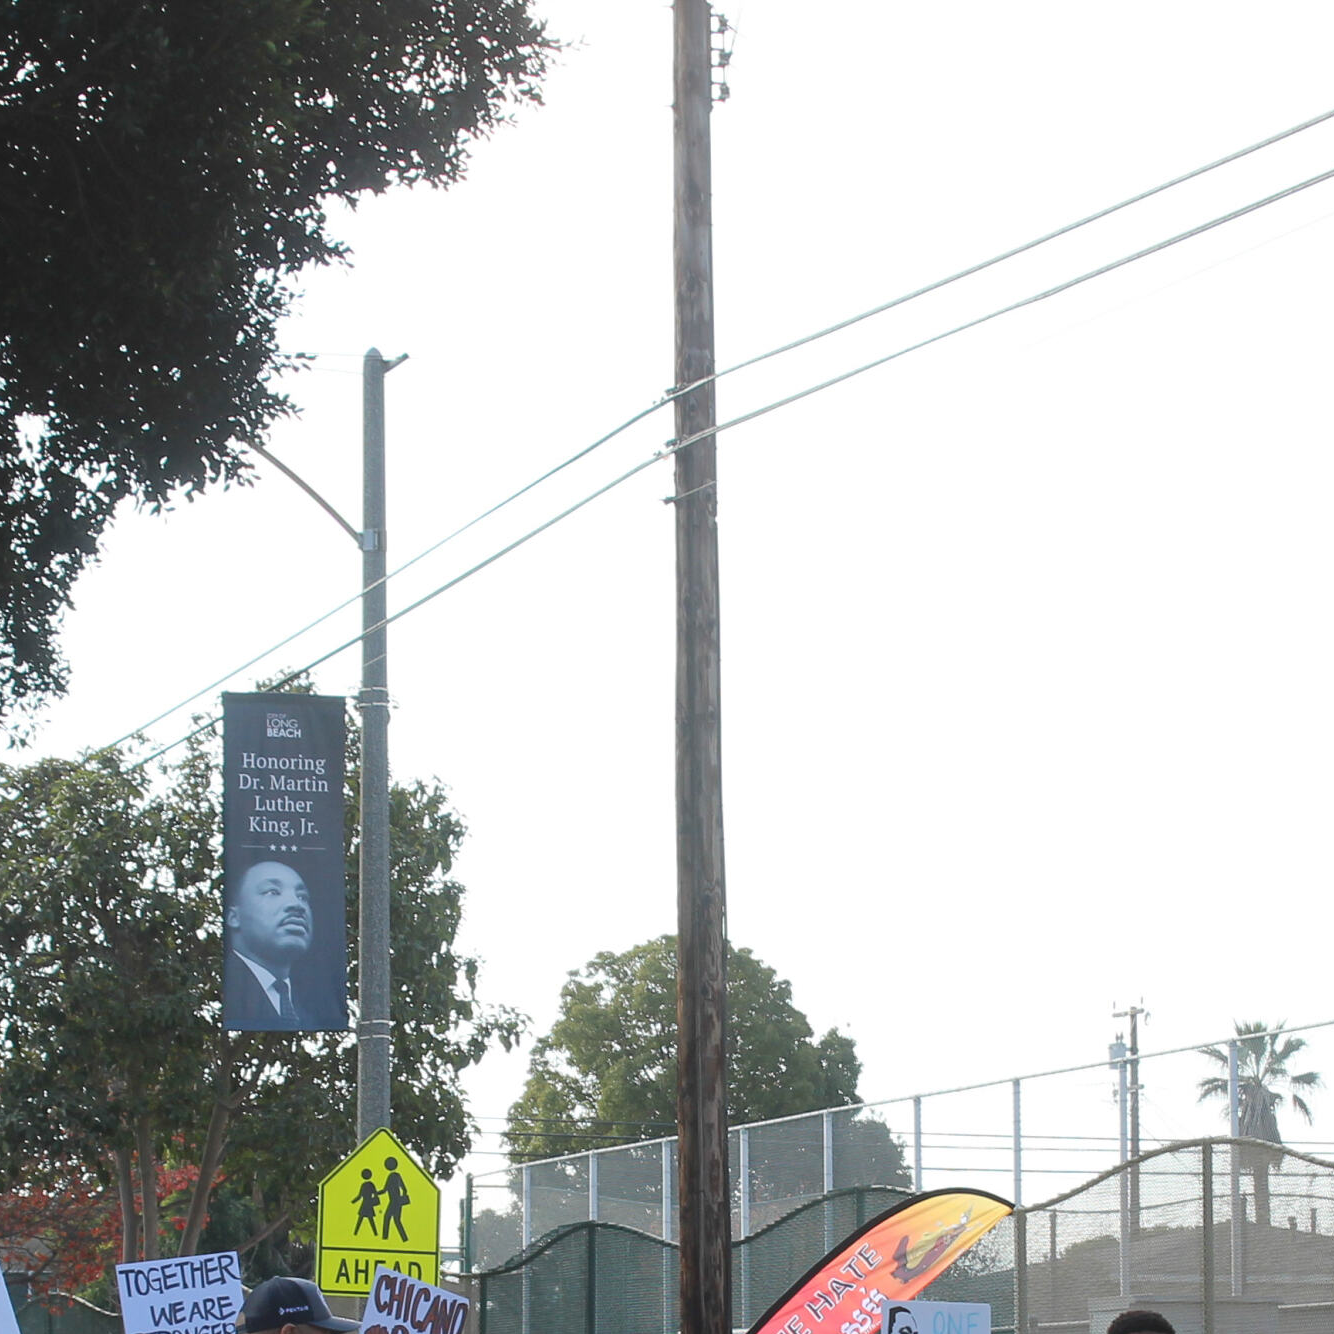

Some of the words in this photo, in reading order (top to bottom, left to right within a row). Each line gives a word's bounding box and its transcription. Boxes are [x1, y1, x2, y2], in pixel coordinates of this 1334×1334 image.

[267, 719, 298, 729] LONG
[267, 729, 301, 739] BEACH
[242, 752, 326, 774] Honoring
[238, 774, 265, 791] Dr.
[269, 775, 329, 792] Martin
[255, 795, 313, 813] Luther
[248, 816, 294, 837] King,
[300, 818, 319, 836] Jr.
[118, 1254, 241, 1297] TOGETHER
[805, 1242, 883, 1322] HATE
[150, 1302, 192, 1327] WE
[192, 1295, 237, 1324] ARE
